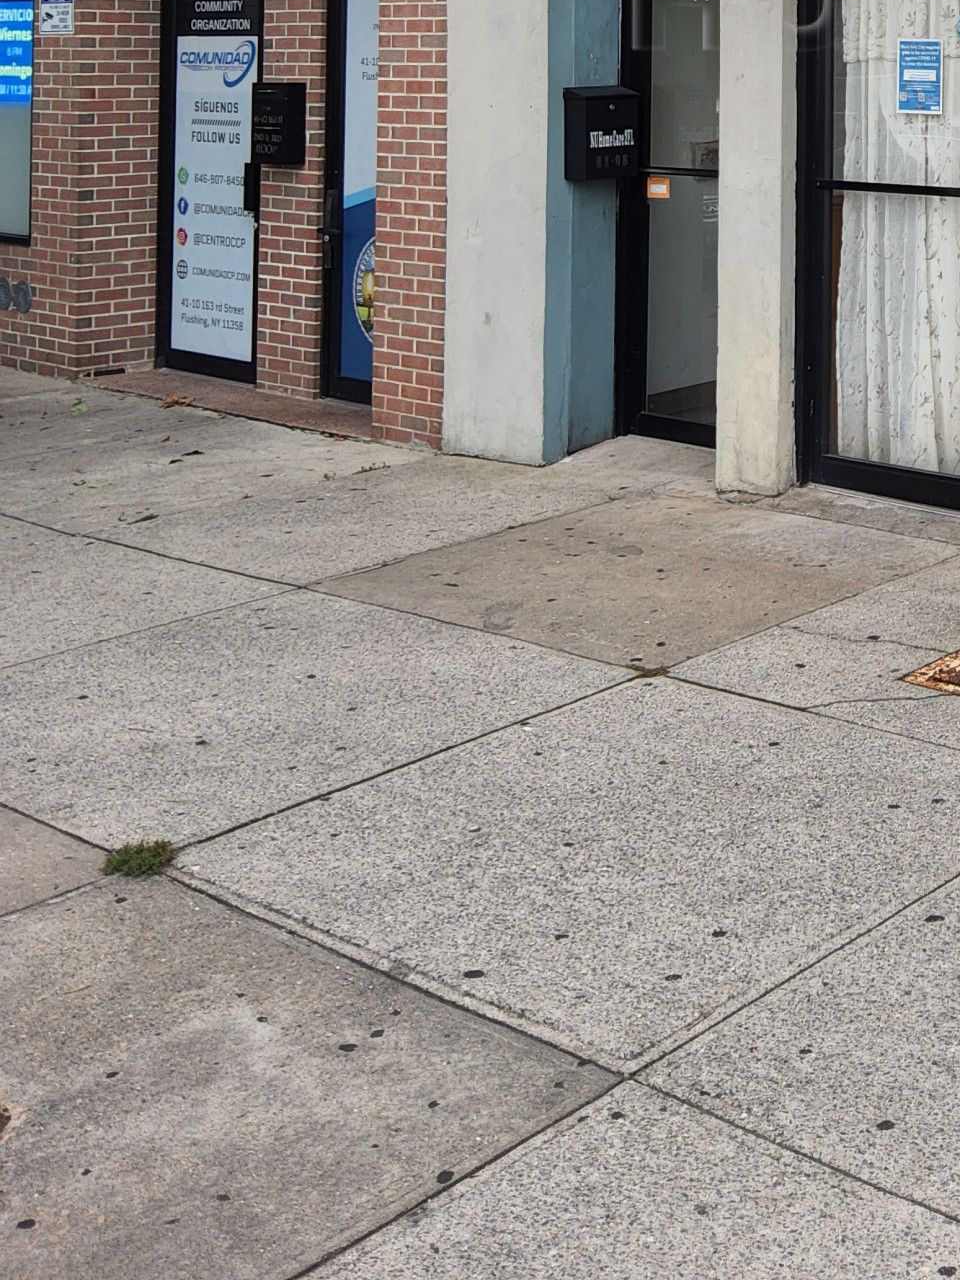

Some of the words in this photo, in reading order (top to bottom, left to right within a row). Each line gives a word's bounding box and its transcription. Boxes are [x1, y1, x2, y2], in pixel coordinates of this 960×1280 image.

[194, 0, 243, 13] COMMUNITY
[191, 19, 250, 31] ORGANIZATION
[180, 51, 250, 65] COMUNIDAD
[194, 98, 239, 114] SÍGUENOS
[191, 131, 225, 144] FOLLOW
[229, 132, 241, 145] US
[211, 318, 222, 328] NY
